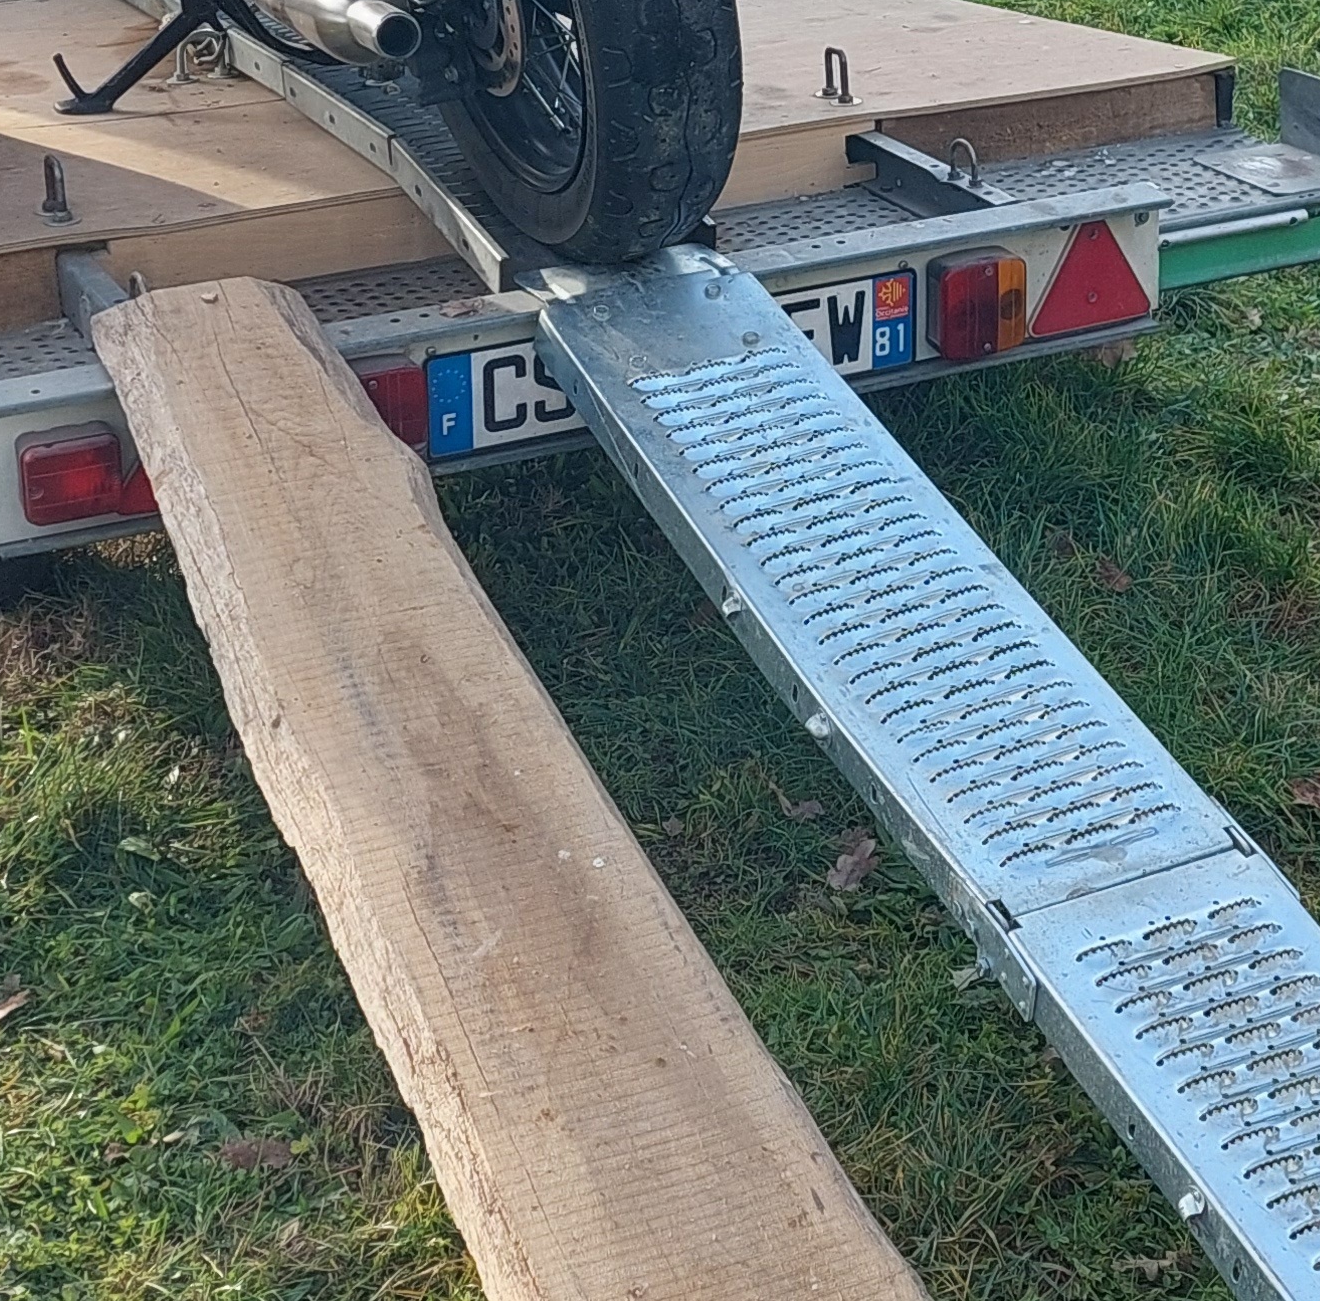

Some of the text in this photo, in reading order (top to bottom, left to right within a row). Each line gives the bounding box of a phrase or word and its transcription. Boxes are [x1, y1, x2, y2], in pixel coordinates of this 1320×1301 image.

[442, 412, 457, 436] F
[483, 354, 576, 432] CS
[875, 323, 905, 356] 81
